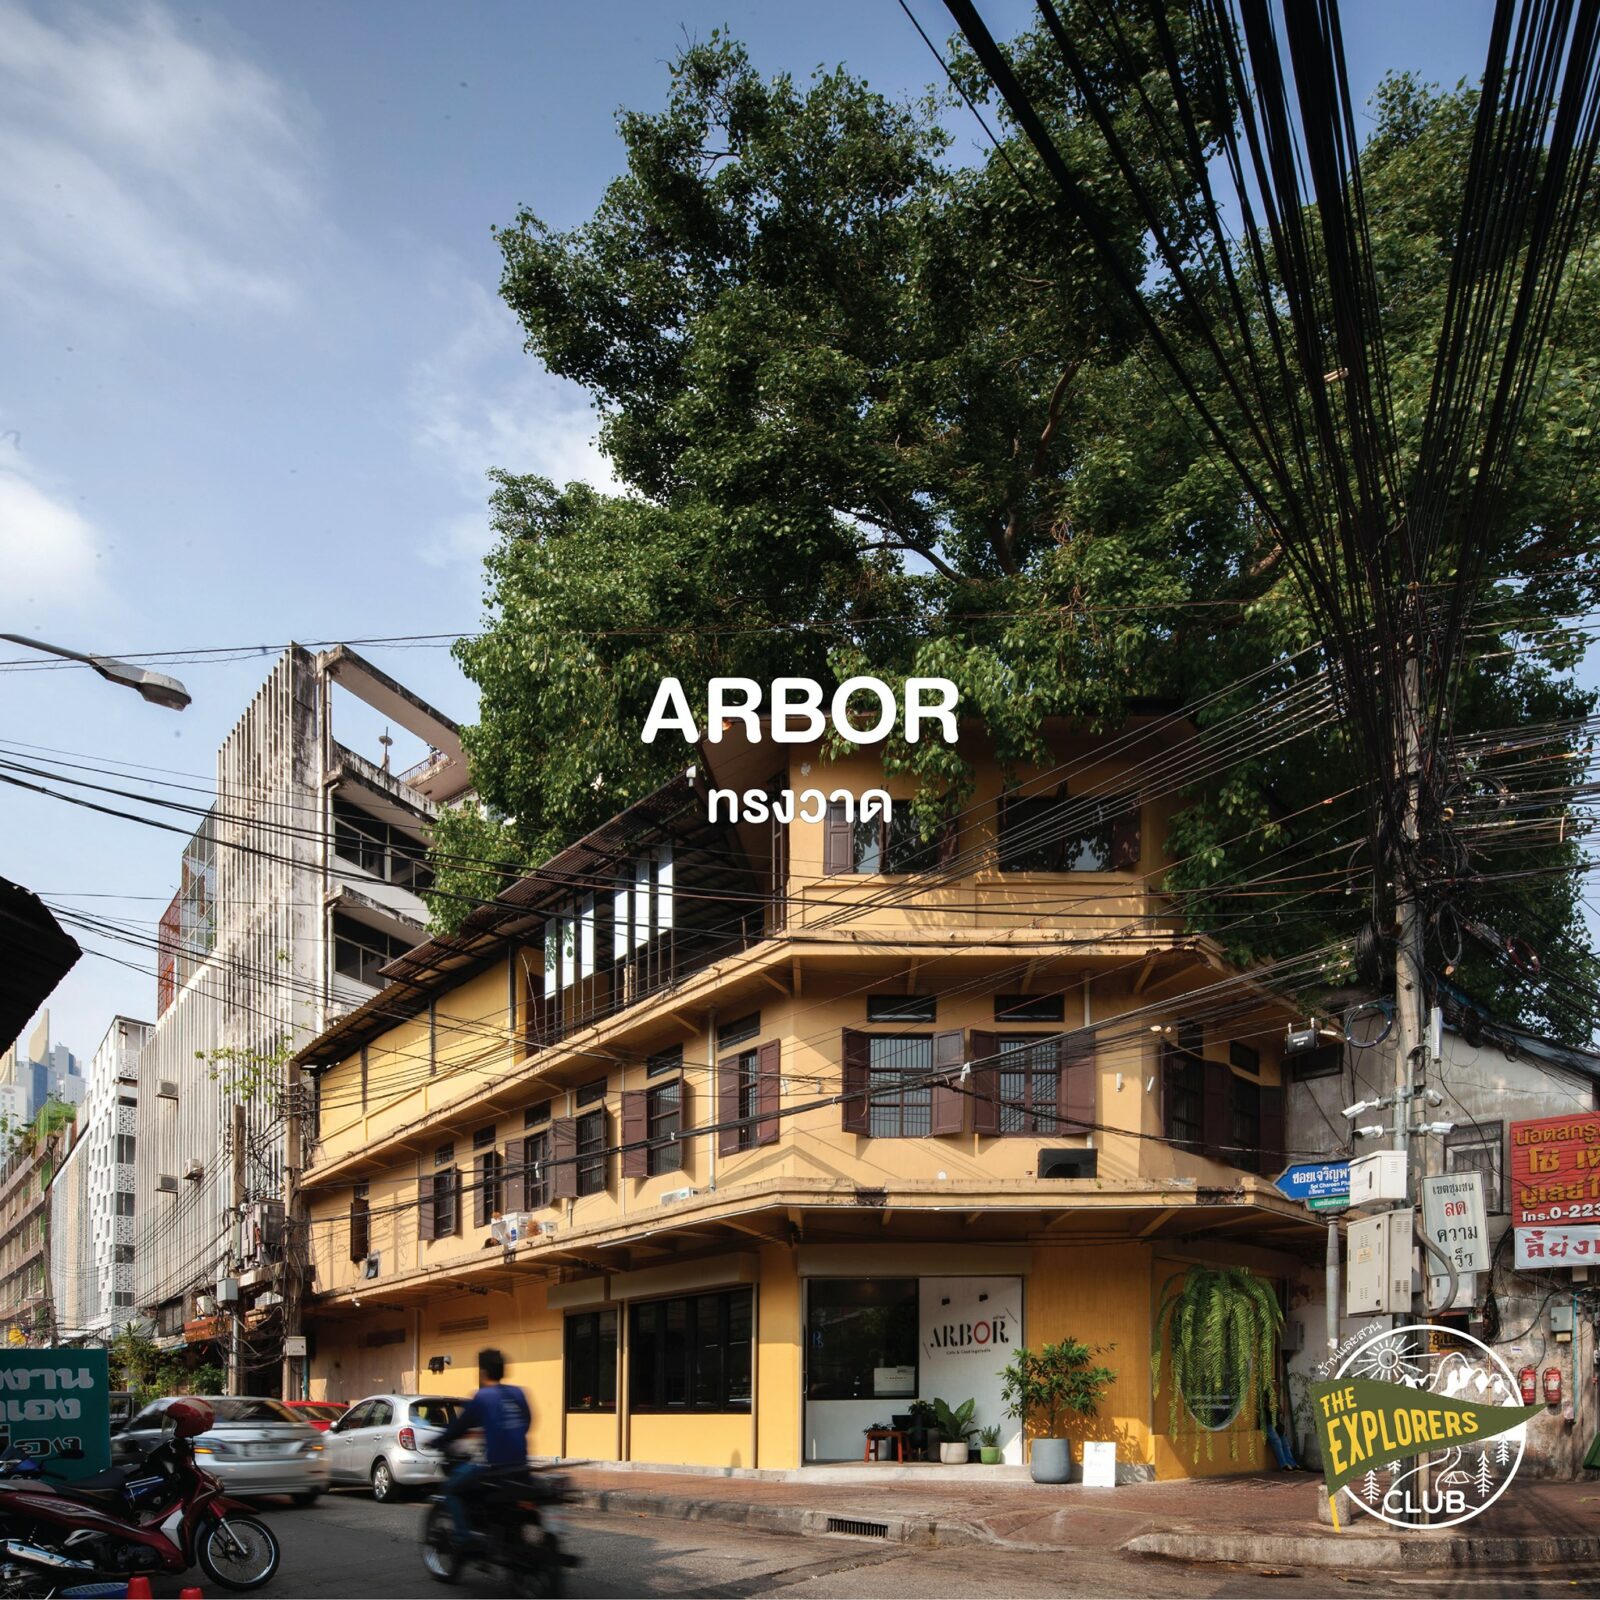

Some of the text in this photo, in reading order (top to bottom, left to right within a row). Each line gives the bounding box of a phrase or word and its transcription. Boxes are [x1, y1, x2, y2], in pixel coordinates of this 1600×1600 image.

[1432, 1182, 1475, 1197] เขตชุมชน
[1444, 1201, 1467, 1217] ลด
[1437, 1226, 1478, 1243] ความ
[930, 1320, 1009, 1348] ARBOR
[0, 1368, 95, 1390] งาน
